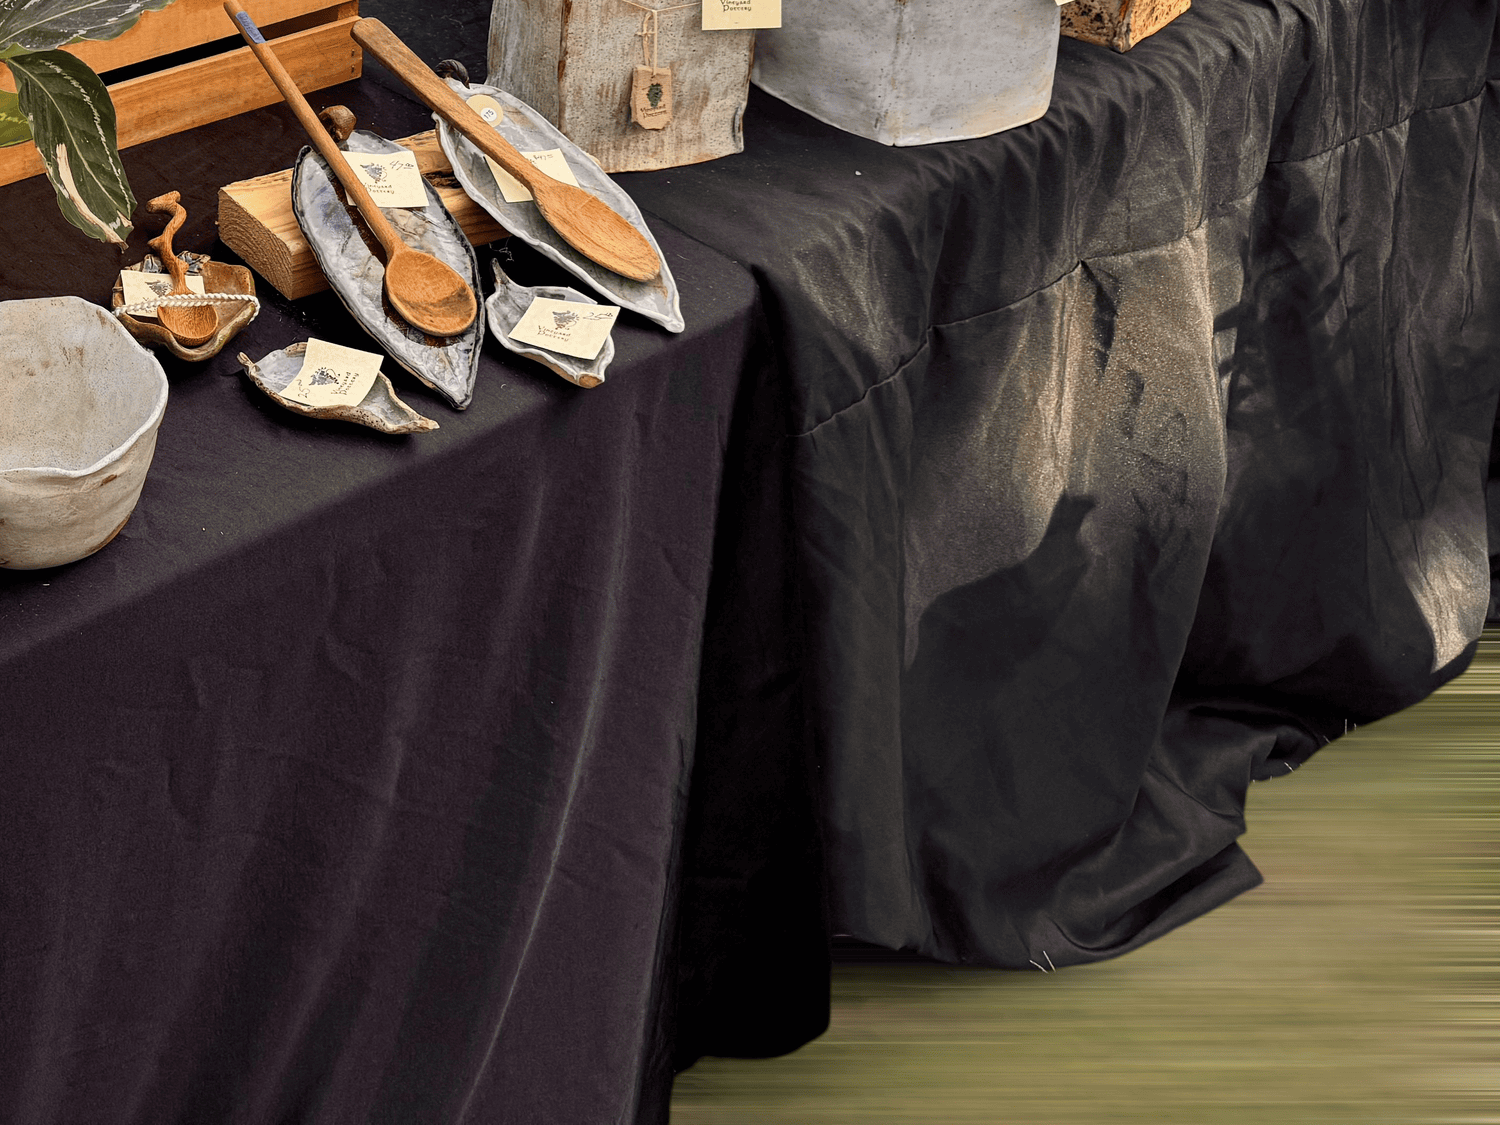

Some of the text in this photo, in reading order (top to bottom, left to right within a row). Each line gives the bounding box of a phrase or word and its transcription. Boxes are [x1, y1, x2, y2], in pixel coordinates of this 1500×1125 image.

[723, 4, 752, 12] Pottery
[330, 371, 352, 395] Vineyard
[339, 372, 360, 396] Pottery
